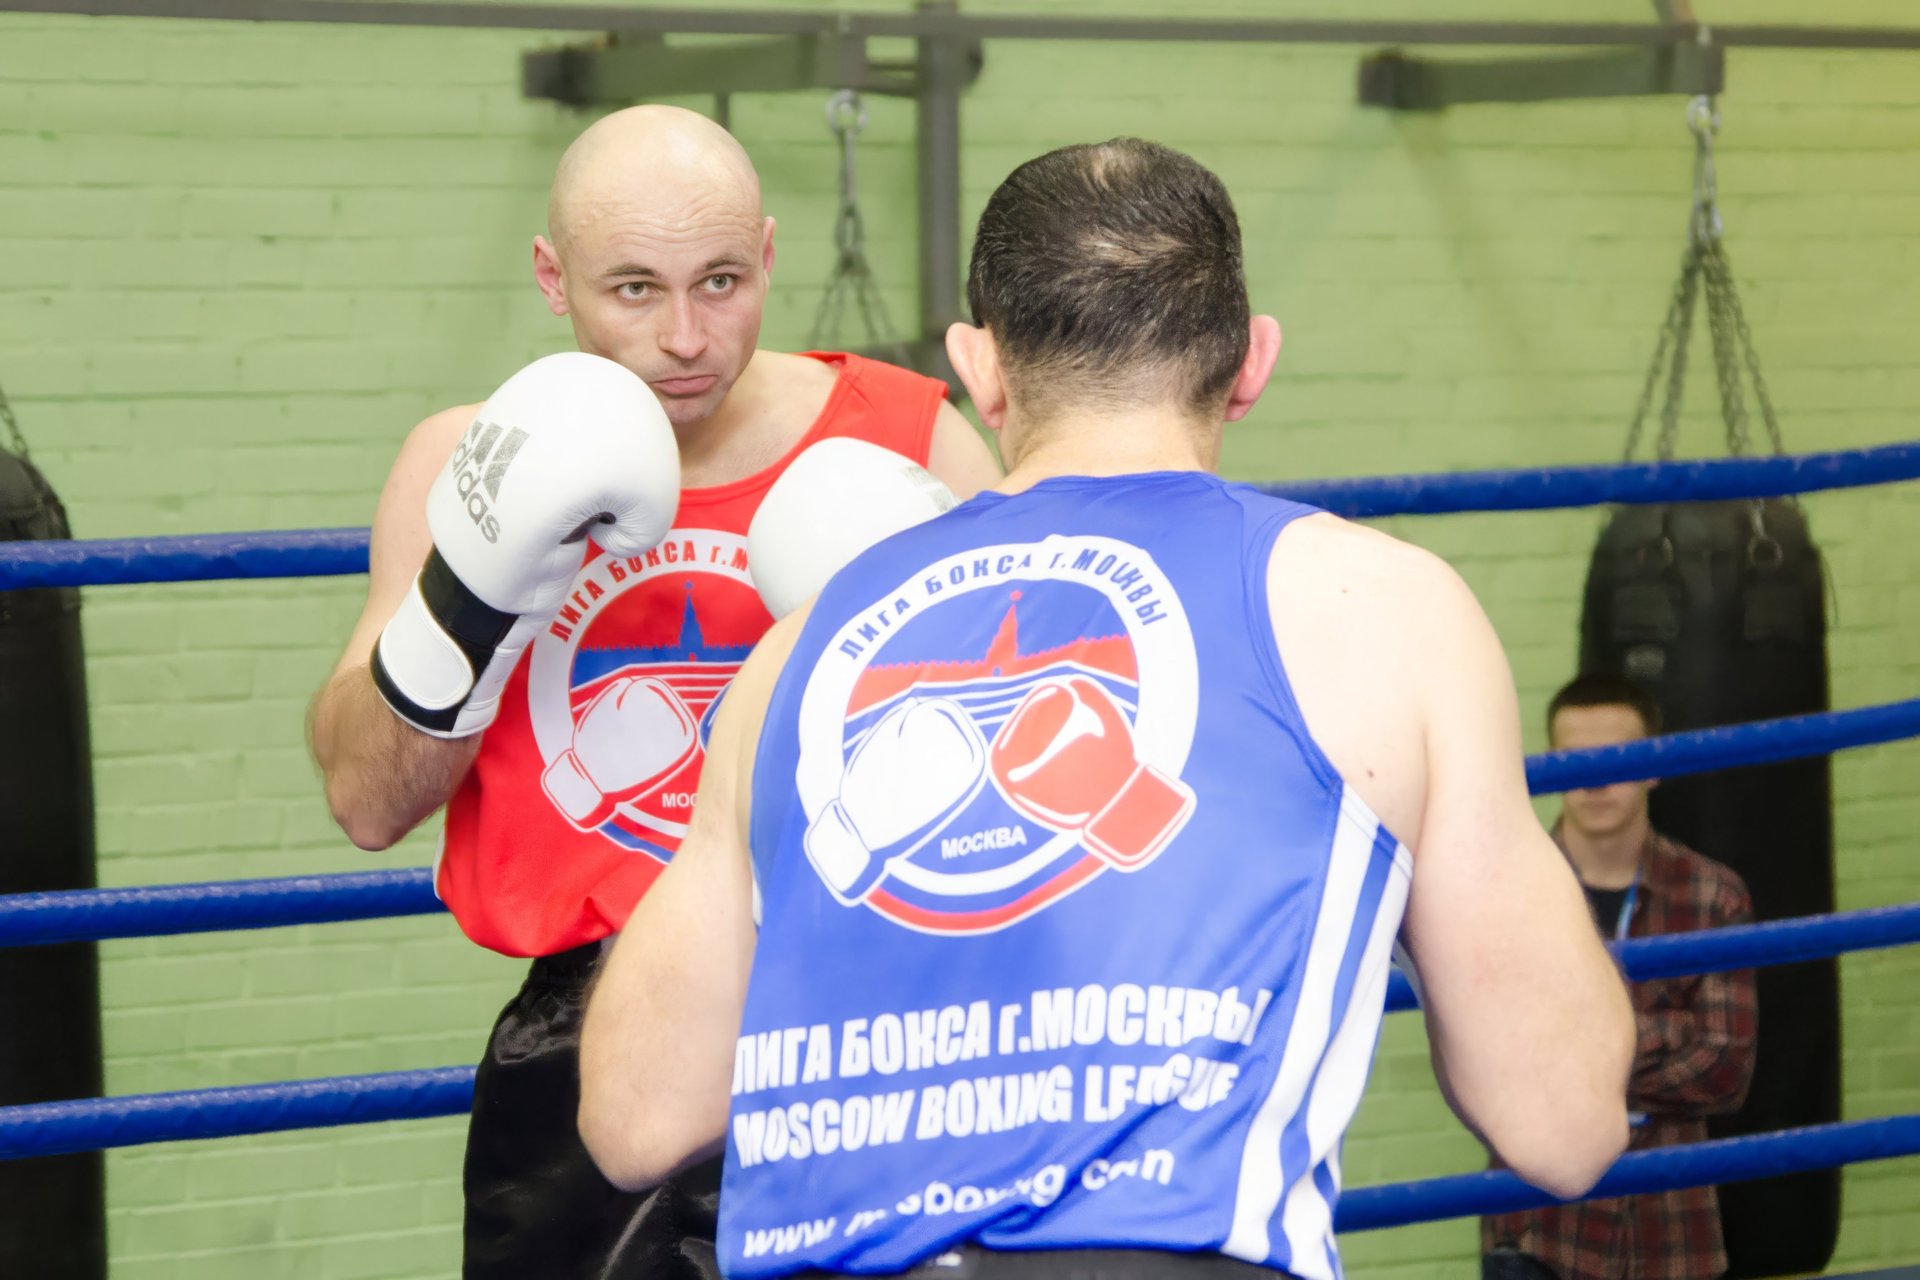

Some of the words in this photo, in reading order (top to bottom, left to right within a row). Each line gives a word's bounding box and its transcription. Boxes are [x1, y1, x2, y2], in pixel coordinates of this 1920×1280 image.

[452, 438, 500, 544] didas
[549, 579, 605, 643] ЛИГА
[839, 597, 910, 659] ЛИГА
[925, 553, 1031, 595] БОКСА
[941, 825, 1027, 859] МОСКВА
[731, 1024, 831, 1096] ЛИГА
[839, 1000, 990, 1078] БОКСА
[733, 1089, 915, 1169] MOSCOW
[915, 1064, 1073, 1141] BOXING
